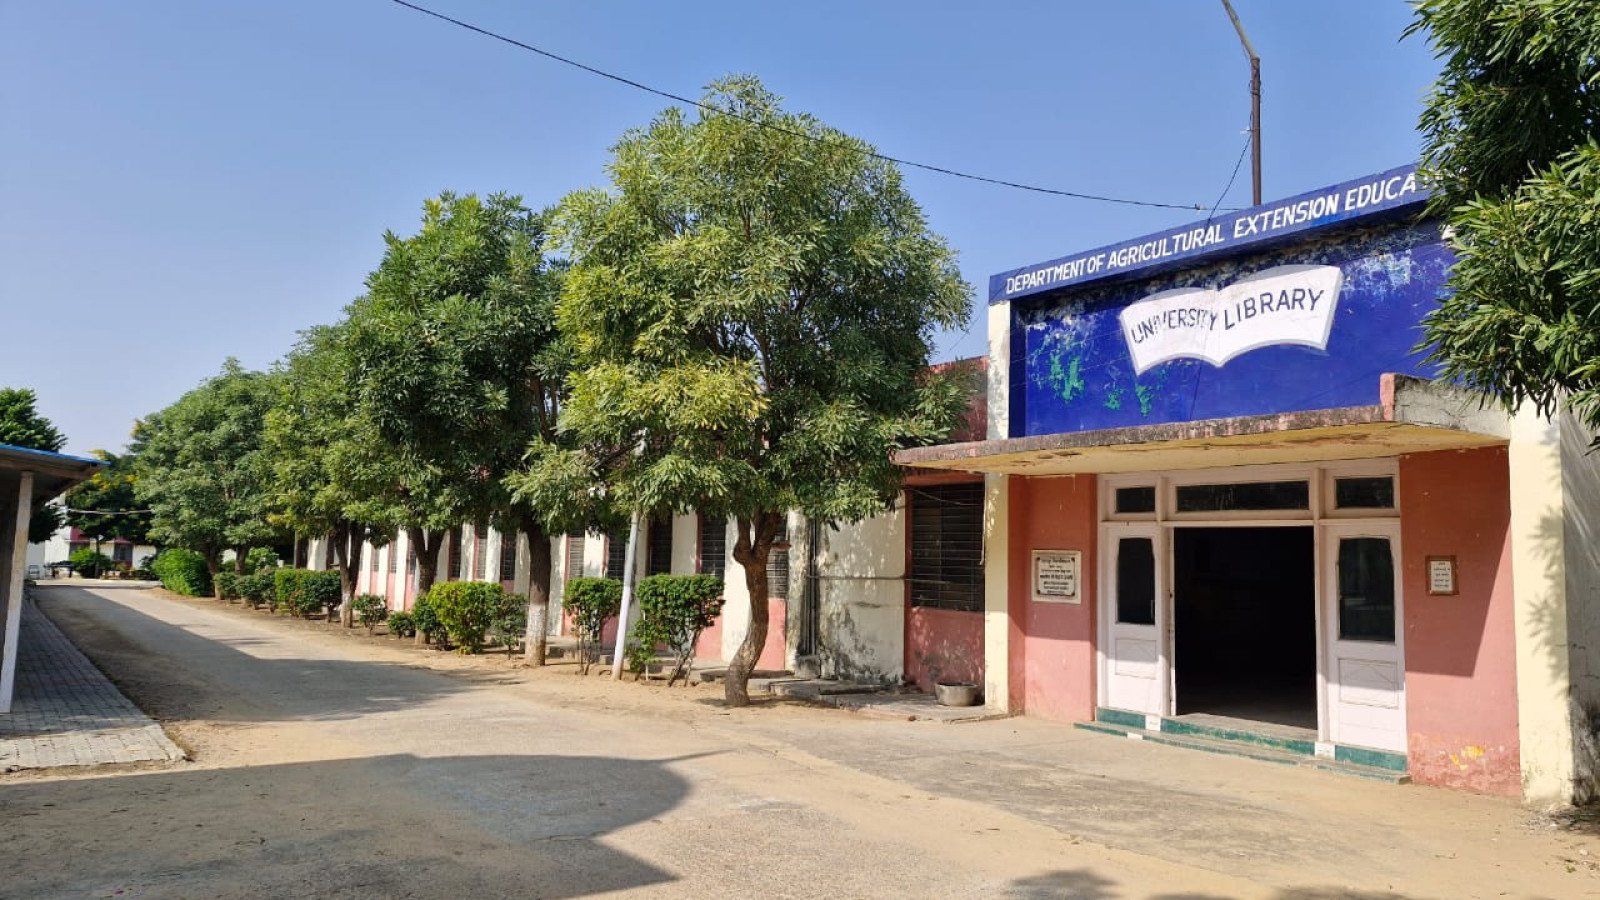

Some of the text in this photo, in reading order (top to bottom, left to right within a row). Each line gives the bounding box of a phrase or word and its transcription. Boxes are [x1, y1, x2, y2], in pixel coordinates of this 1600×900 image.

[1006, 168, 1428, 295] DEPARTMENT OF AGRICULTURAL EXTENSION EDUCA
[1223, 288, 1325, 330] LIBRARY
